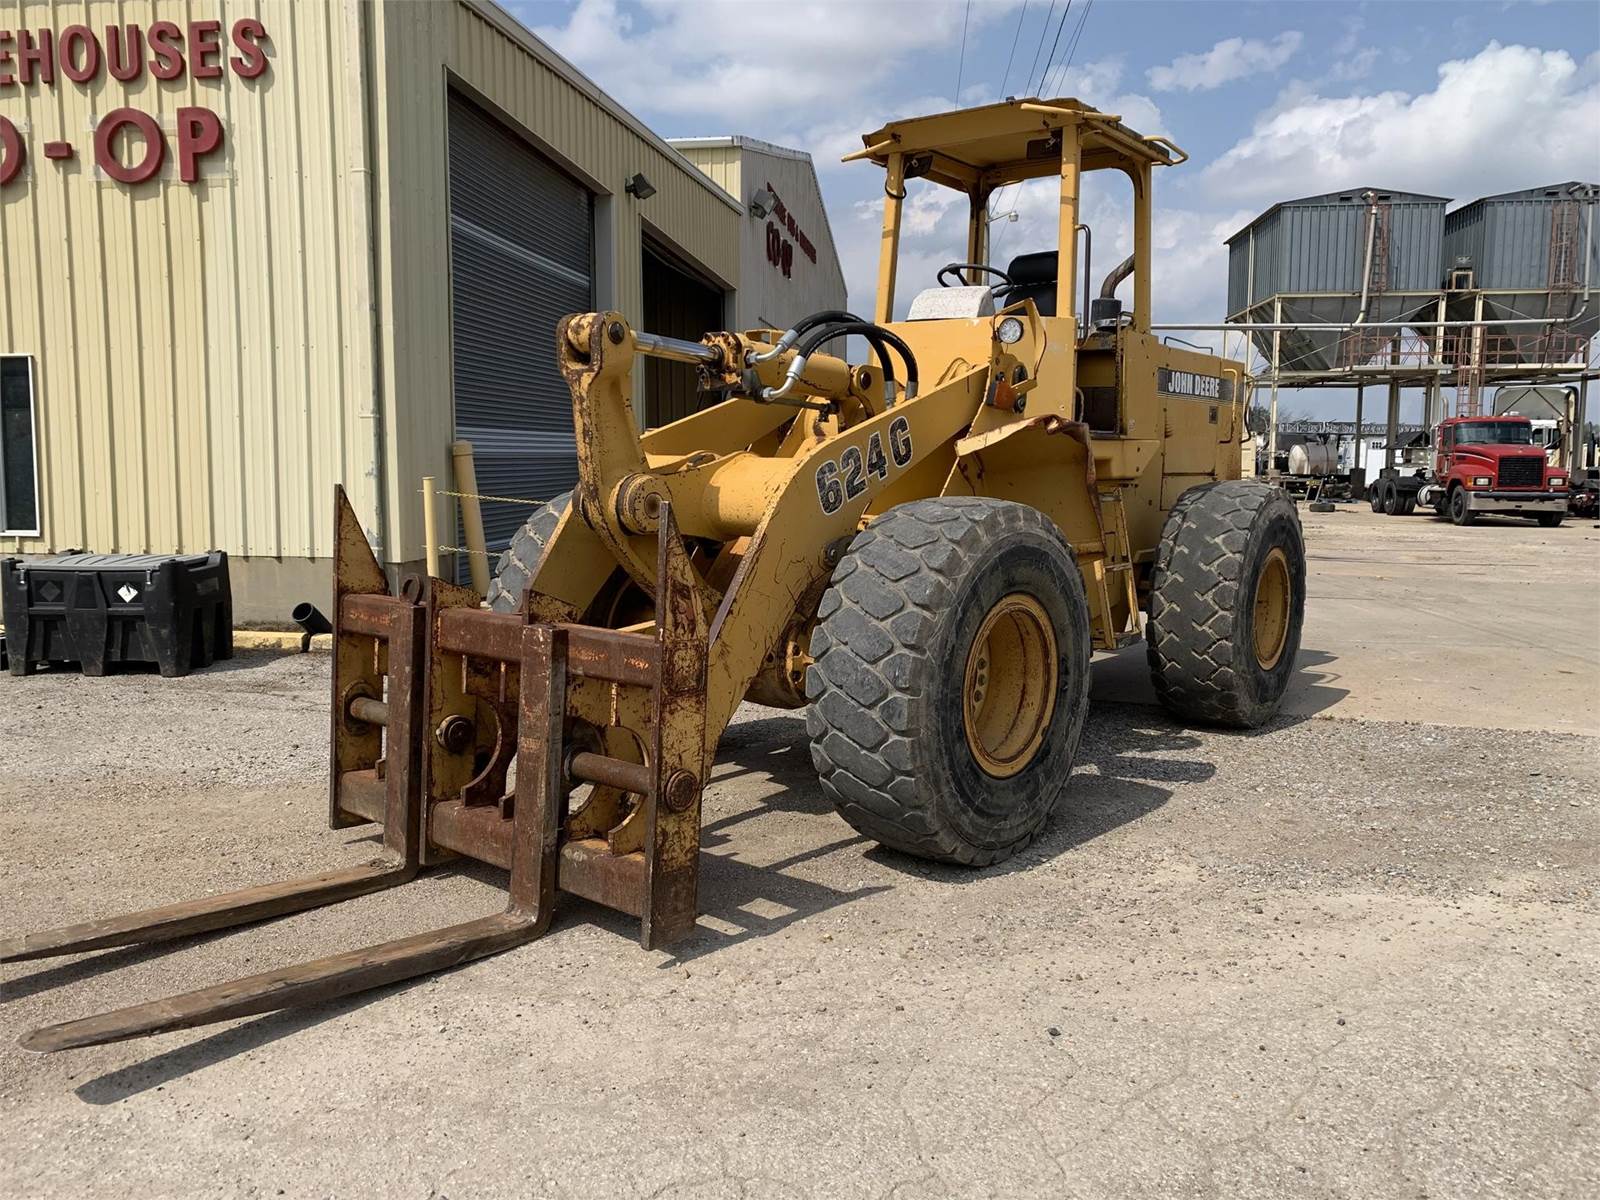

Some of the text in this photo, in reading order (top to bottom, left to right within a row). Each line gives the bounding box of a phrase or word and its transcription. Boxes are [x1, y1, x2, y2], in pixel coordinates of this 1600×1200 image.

[1168, 371, 1220, 398] JOHN DEERE
[815, 416, 913, 515] 624G
